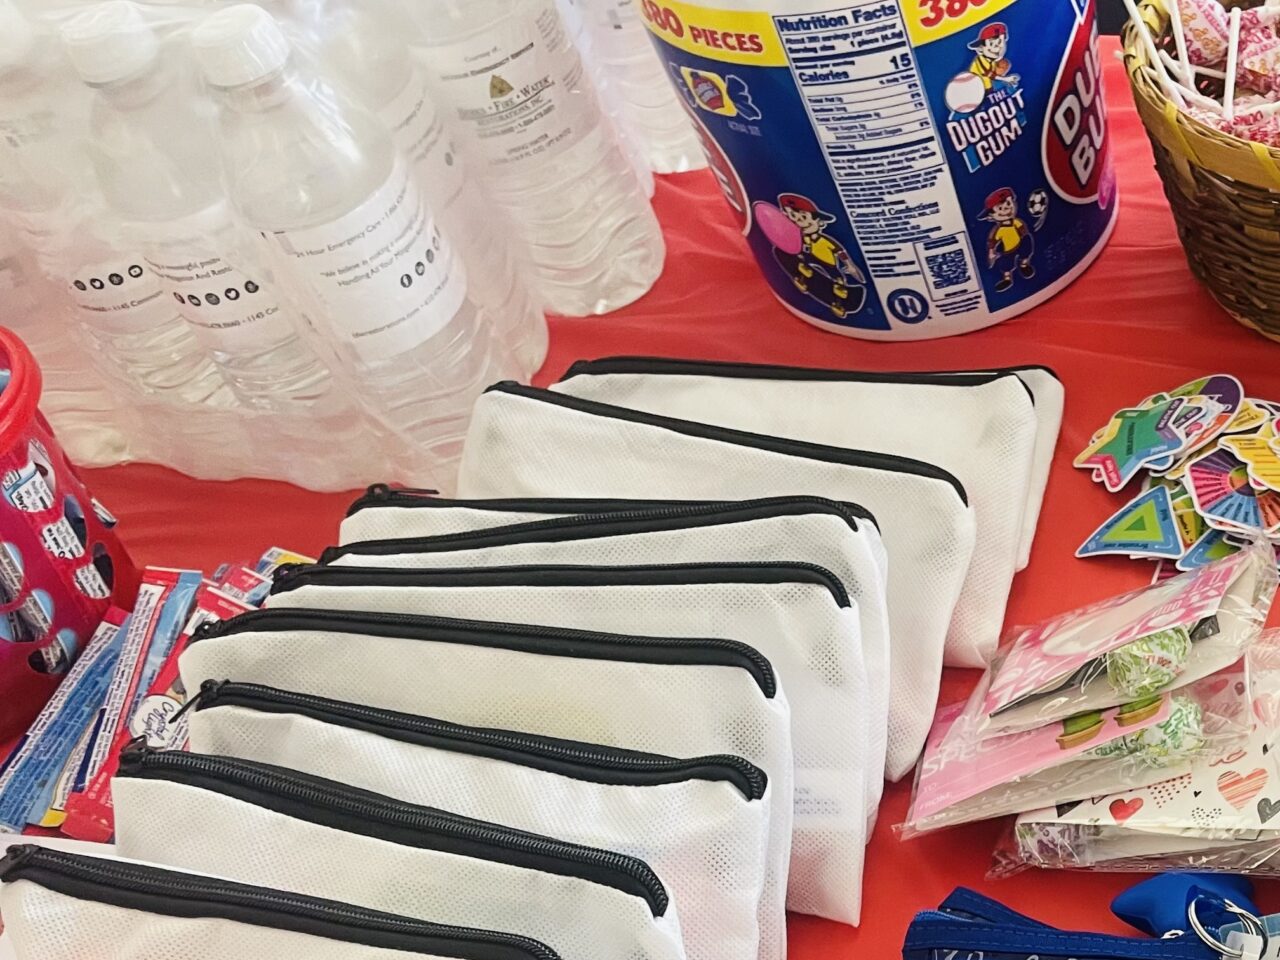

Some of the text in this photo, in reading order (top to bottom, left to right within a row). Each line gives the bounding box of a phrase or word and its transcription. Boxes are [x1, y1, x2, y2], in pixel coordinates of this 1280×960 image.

[776, 4, 897, 32] Nutrition Facts
[688, 25, 763, 53] PIECES
[799, 52, 912, 83] Calories 15
[988, 91, 1007, 104] THE
[946, 88, 1024, 151] DUGOUT
[976, 118, 1022, 167] GUM
[327, 231, 365, 251] Emergency
